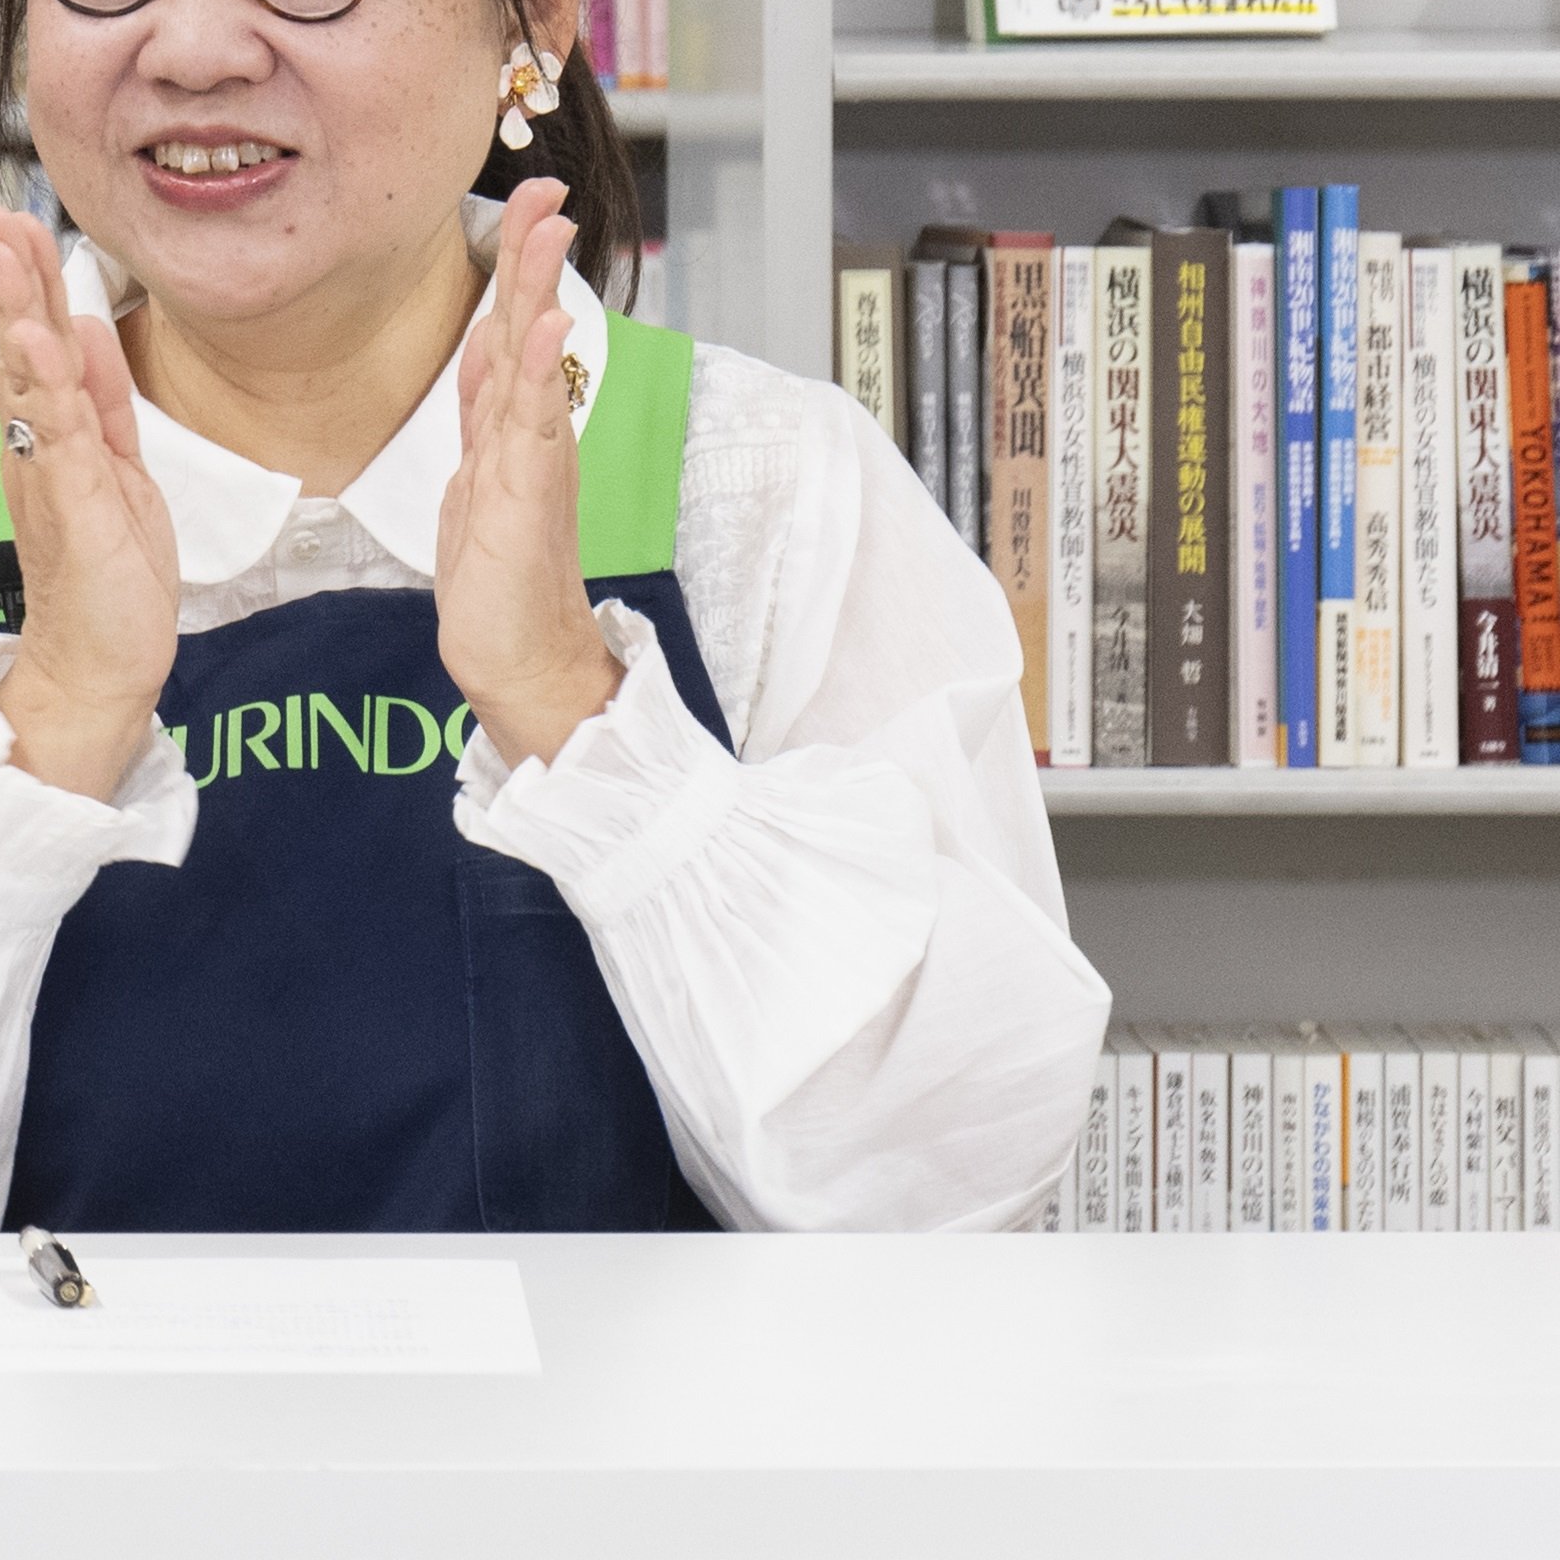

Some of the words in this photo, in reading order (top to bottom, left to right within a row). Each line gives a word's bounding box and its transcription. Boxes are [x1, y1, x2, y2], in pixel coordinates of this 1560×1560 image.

[1009, 261, 1046, 459] 黒船異聞
[1107, 265, 1140, 542] 横浜の関東大震災
[1178, 261, 1206, 575] 相州自由民権運動の展開
[1365, 323, 1393, 443] 都市経営
[1460, 265, 1501, 542] 横浜の関東大震災
[1061, 352, 1086, 607] 横浜の女性宣教師たち
[1366, 511, 1389, 613] 高秀秀信
[1413, 353, 1437, 609] 横浜の女性宣教師たち
[1085, 1084, 1109, 1225] 神奈川の記憶
[1240, 1083, 1265, 1224] 神奈川の記憶
[1390, 1083, 1412, 1206] 浦賀奉行所
[1494, 1095, 1518, 1231] 祖父パーマー
